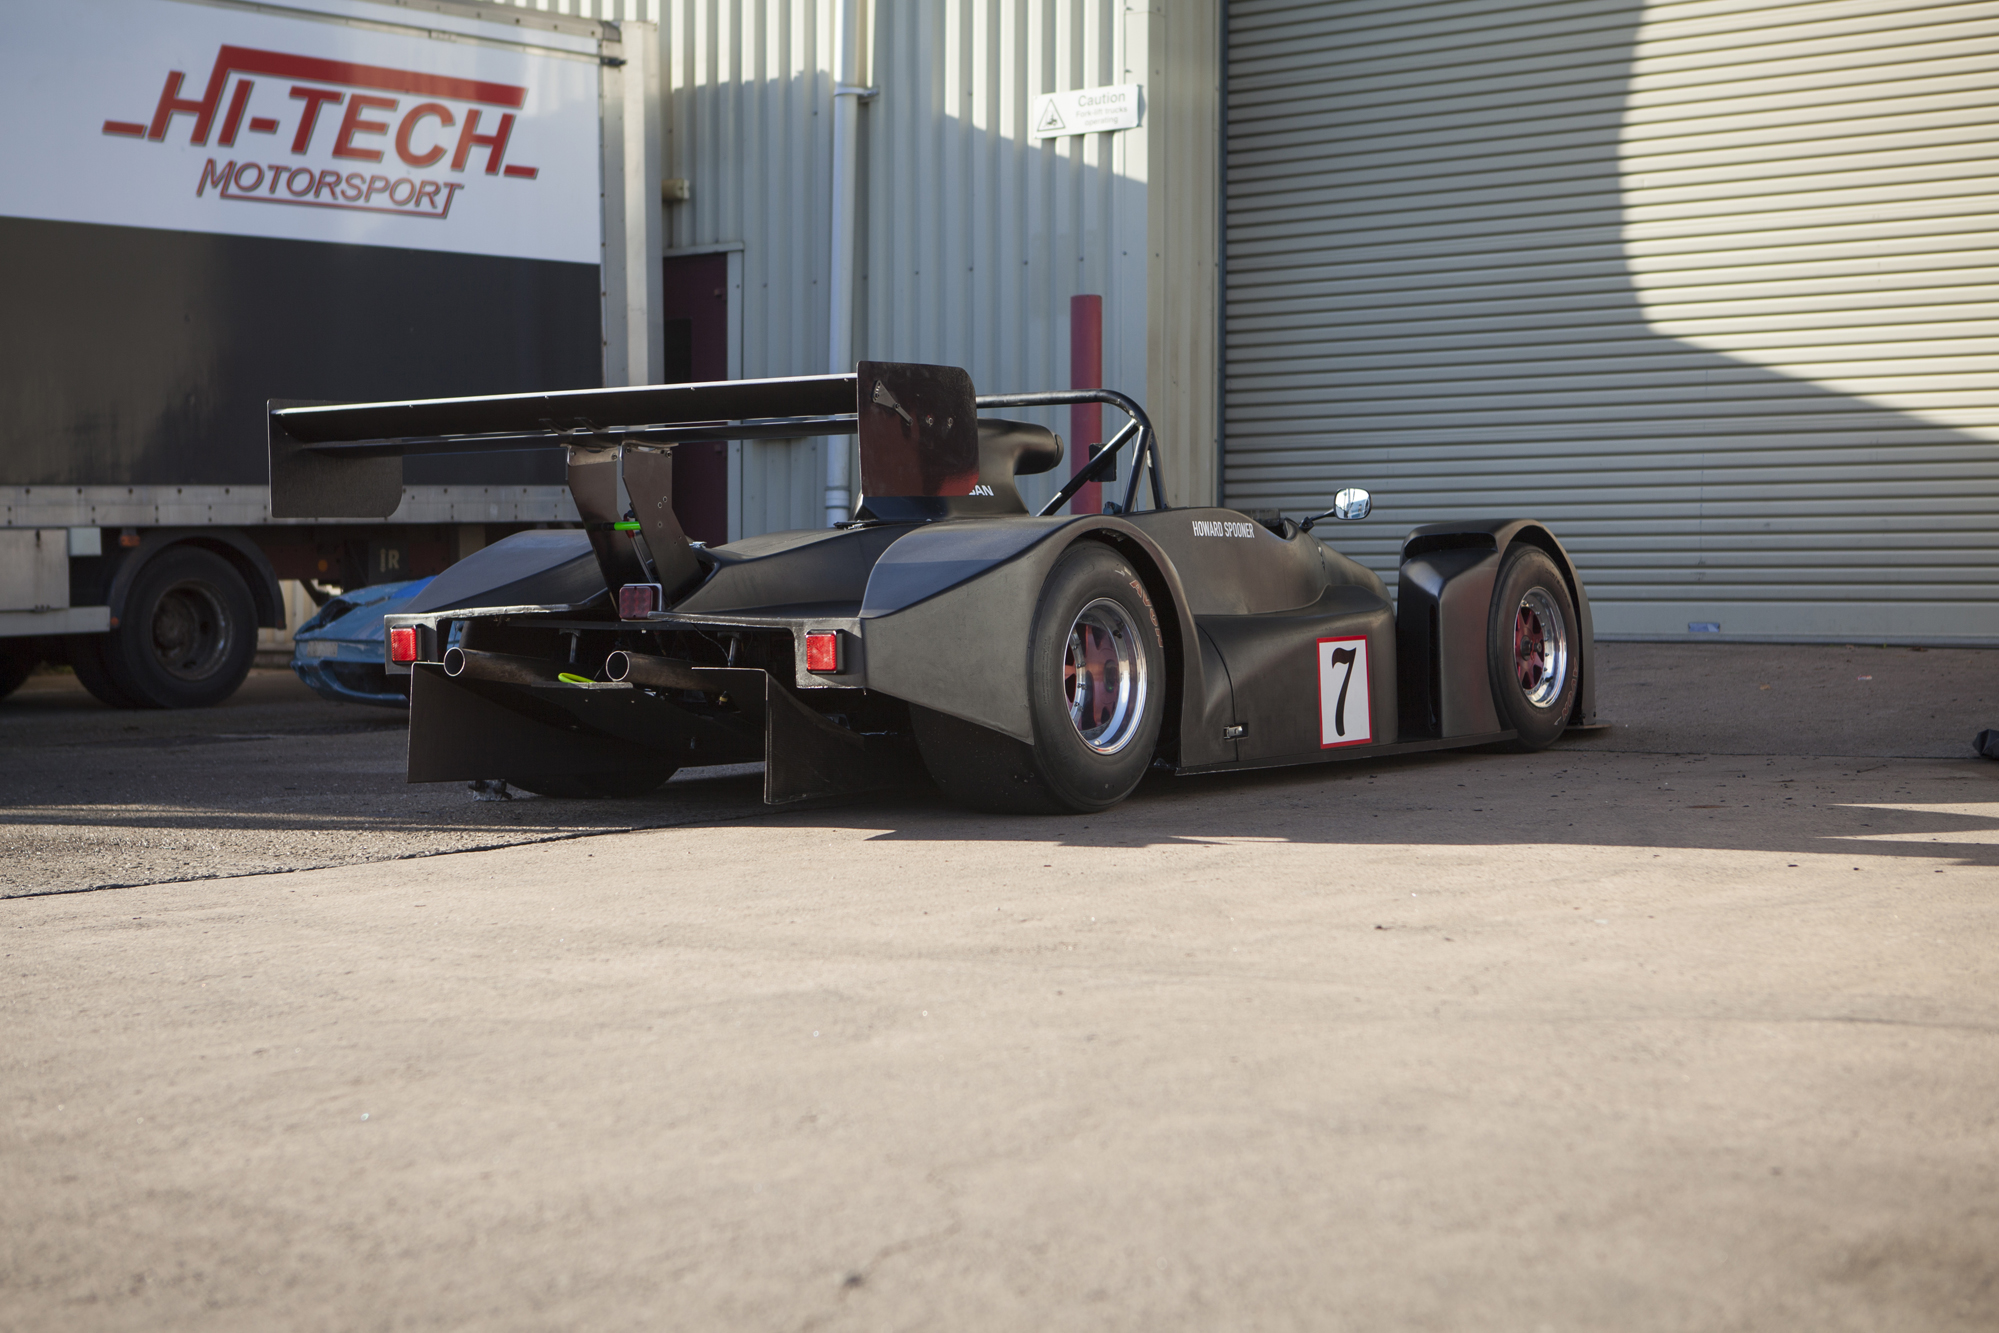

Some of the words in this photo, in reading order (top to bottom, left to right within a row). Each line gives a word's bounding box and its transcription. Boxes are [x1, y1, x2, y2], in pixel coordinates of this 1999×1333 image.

[147, 44, 528, 177] HI-TECH
[1078, 93, 1126, 107] Caution
[1105, 106, 1128, 114] trucks
[1085, 116, 1118, 126] operating
[196, 158, 464, 219] MOTORSPORT
[1192, 521, 1223, 537] HOWARD
[1223, 522, 1255, 538] SPOONER
[1129, 580, 1163, 648] AVON
[1331, 647, 1357, 737] 7
